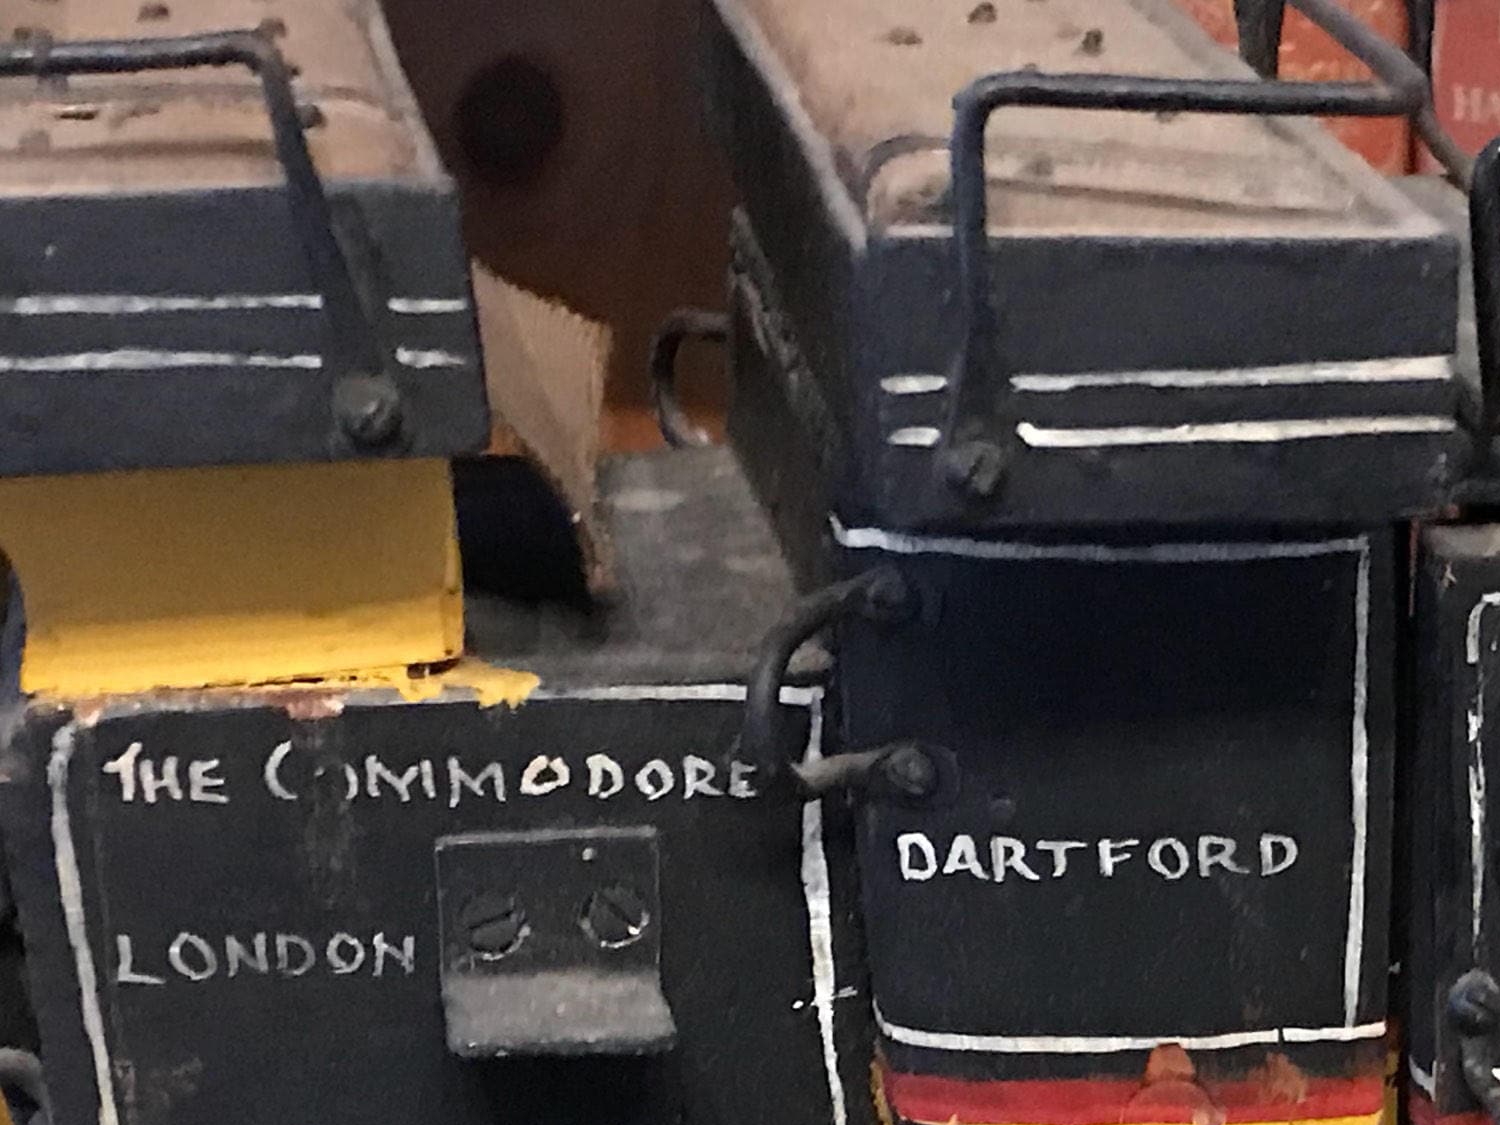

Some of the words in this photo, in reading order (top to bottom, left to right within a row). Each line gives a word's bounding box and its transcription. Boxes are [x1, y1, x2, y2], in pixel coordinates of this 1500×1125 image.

[102, 741, 230, 803] THE
[896, 832, 1299, 883] DARTFORD
[115, 931, 415, 984] LONDON
